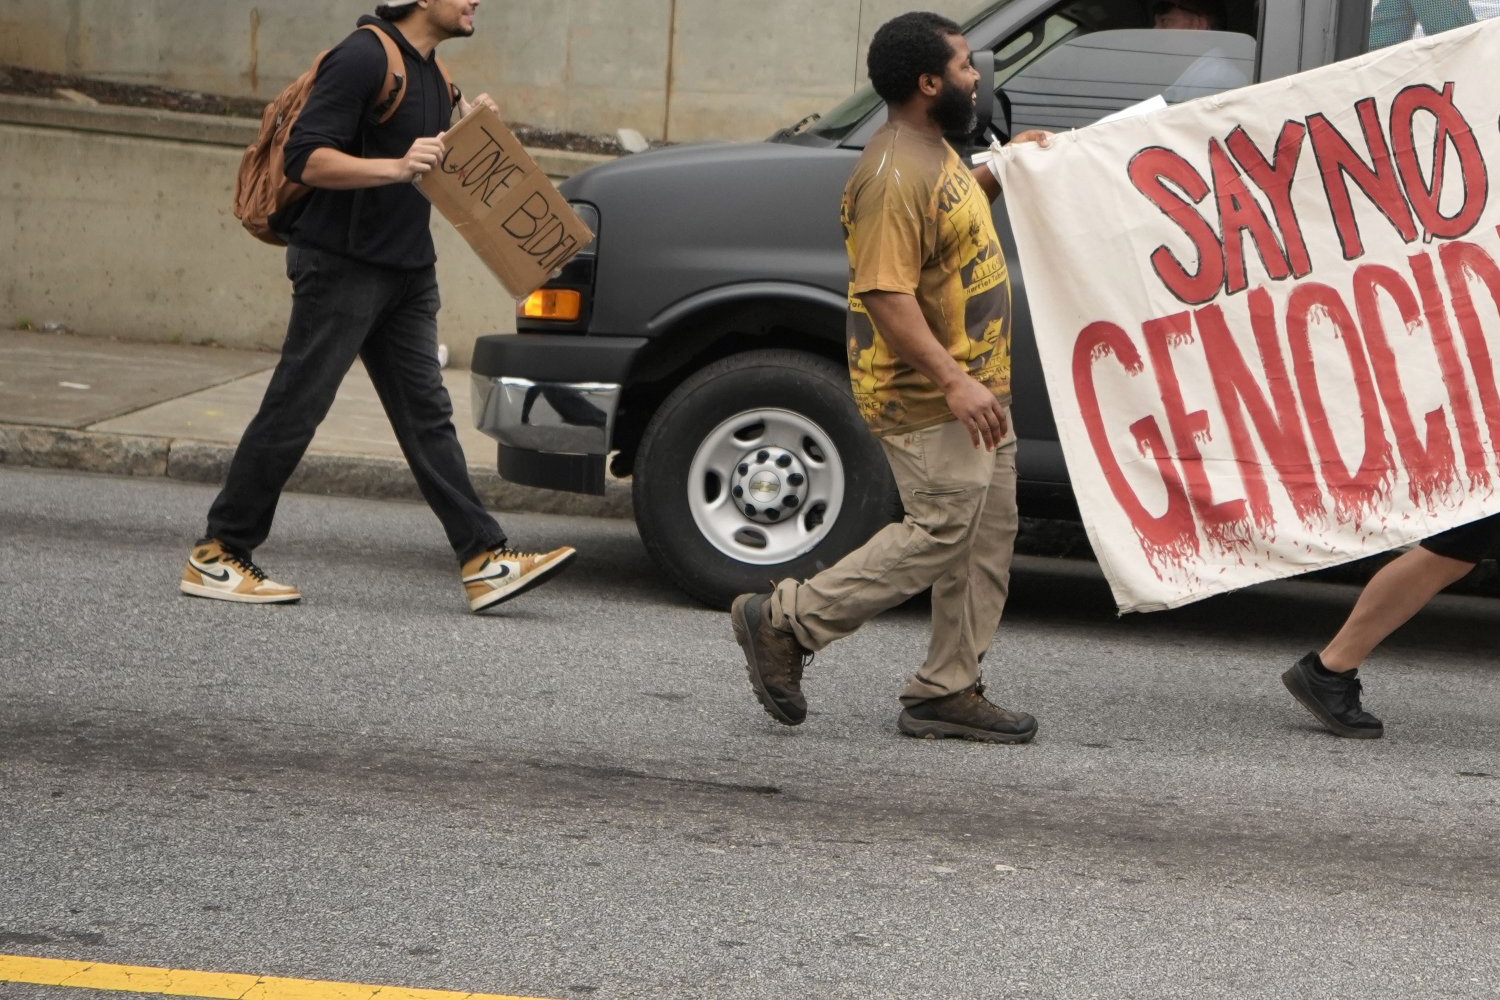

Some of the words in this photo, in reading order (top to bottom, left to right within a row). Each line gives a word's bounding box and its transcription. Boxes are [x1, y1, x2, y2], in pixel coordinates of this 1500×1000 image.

[441, 125, 525, 209] JOKE
[1127, 114, 1312, 305] SAY
[500, 190, 582, 275] BIDEN
